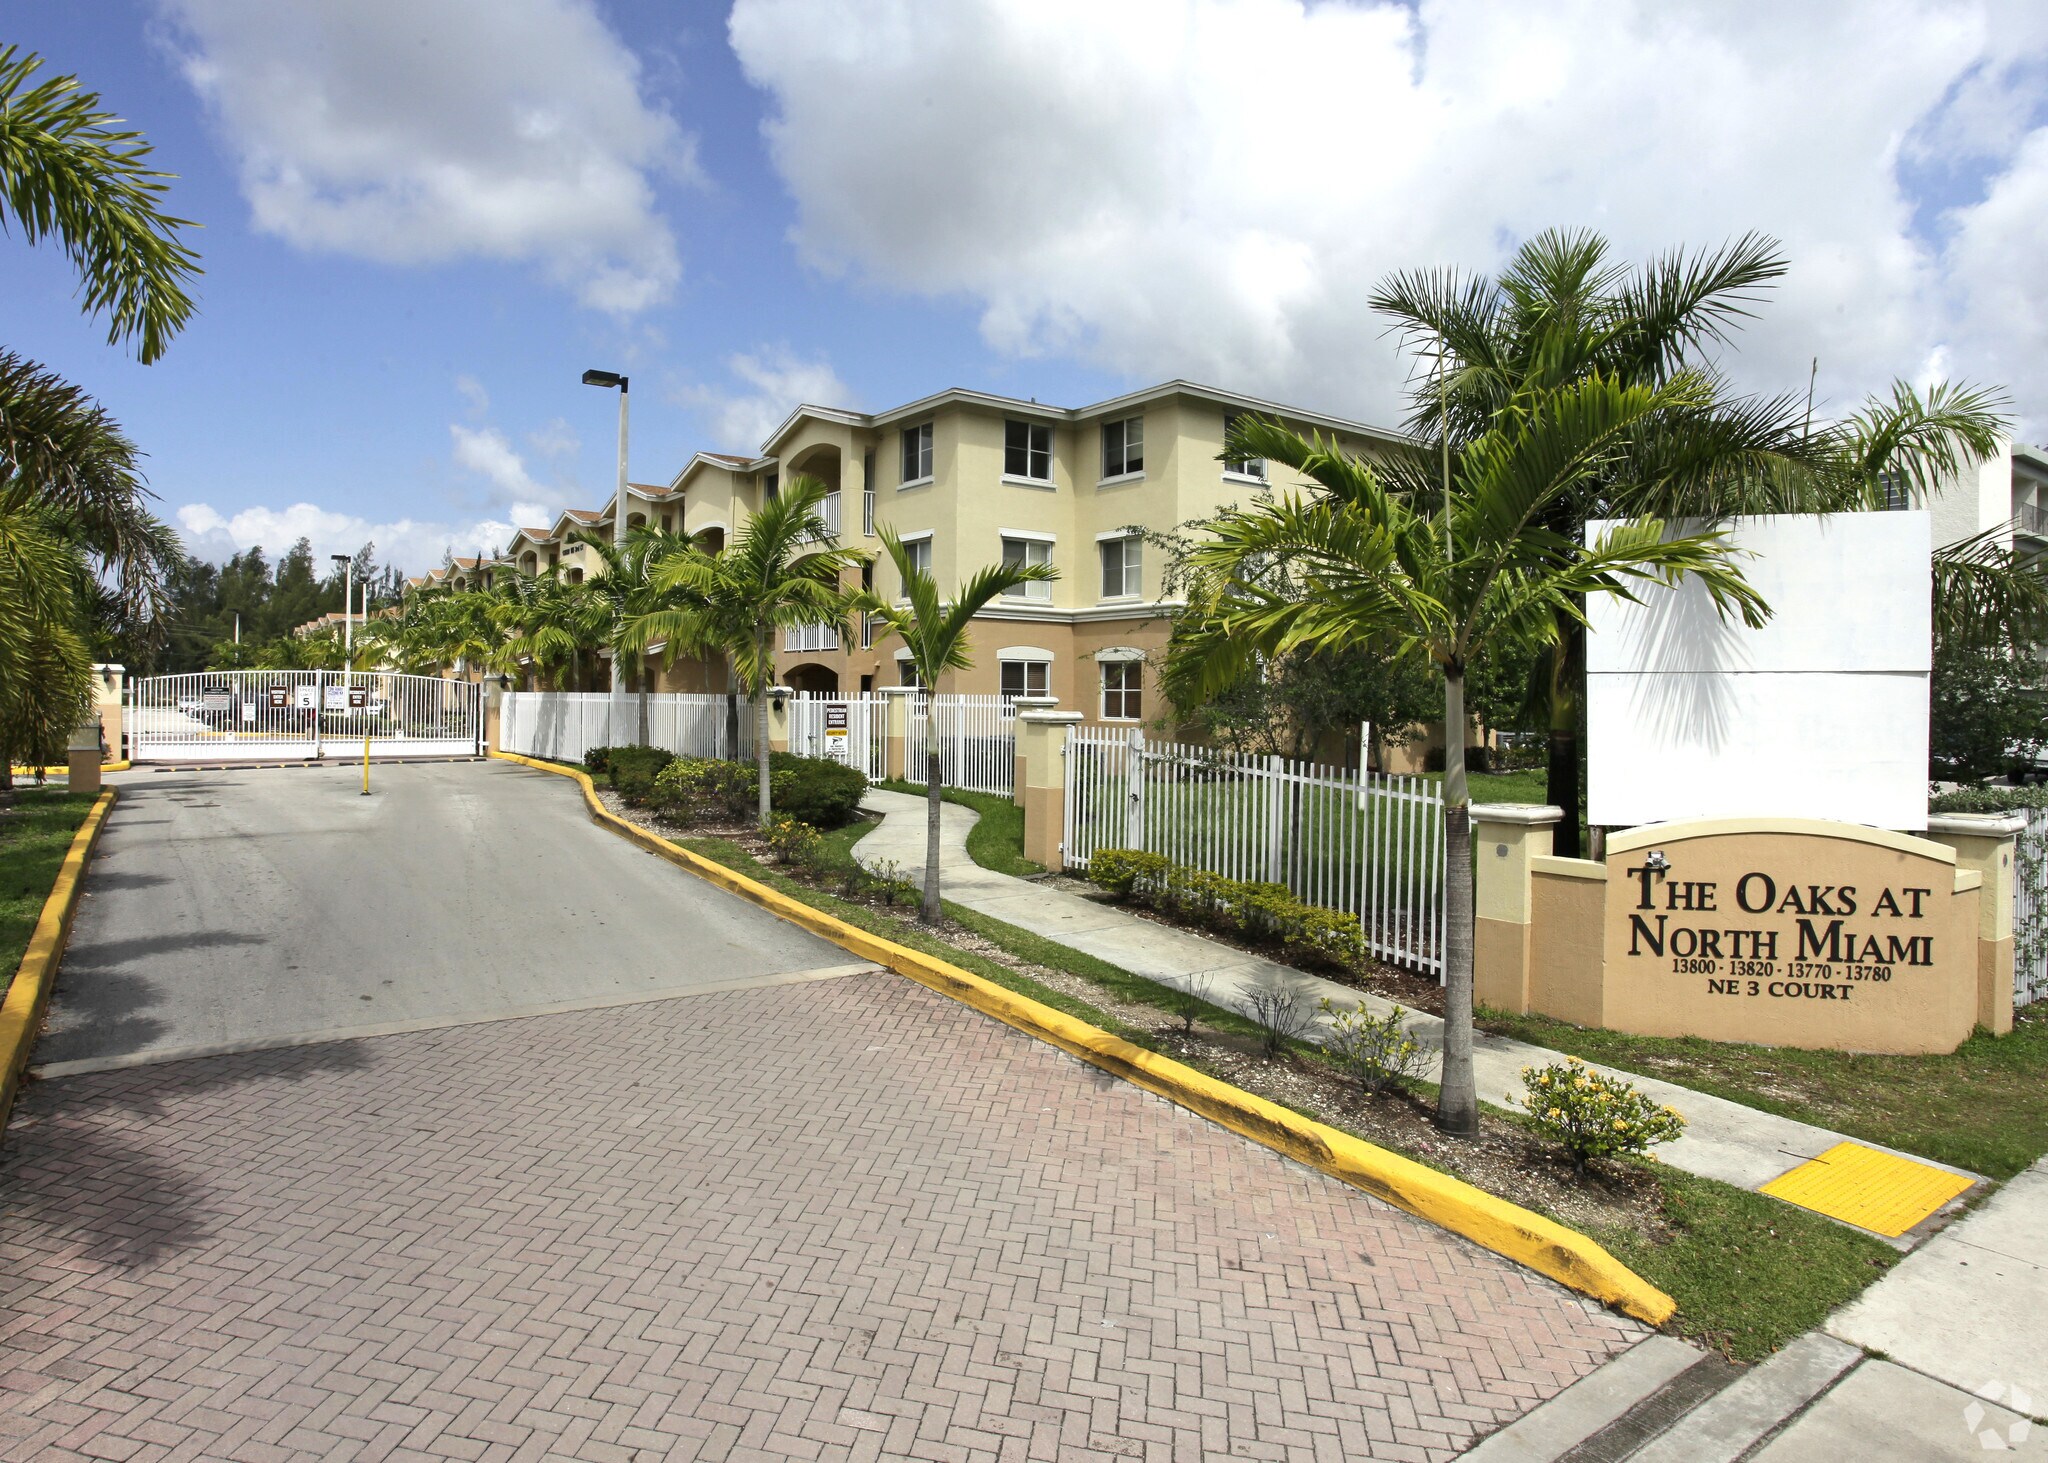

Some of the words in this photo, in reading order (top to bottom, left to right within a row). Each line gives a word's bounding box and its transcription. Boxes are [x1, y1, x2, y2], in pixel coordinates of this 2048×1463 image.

[1627, 868, 1717, 911] THE
[1736, 872, 1857, 916] OAKS
[1871, 887, 1931, 918] AT
[1627, 914, 1779, 961] NORTH
[1794, 918, 1934, 966] MIAMI
[1672, 958, 1716, 974] 13800
[1729, 961, 1774, 977] 13820
[1787, 963, 1832, 979] 13770
[1845, 965, 1891, 982] 13780
[1707, 979, 1740, 996] NE
[1747, 981, 1760, 996] 3
[1768, 981, 1854, 1000] COURT
